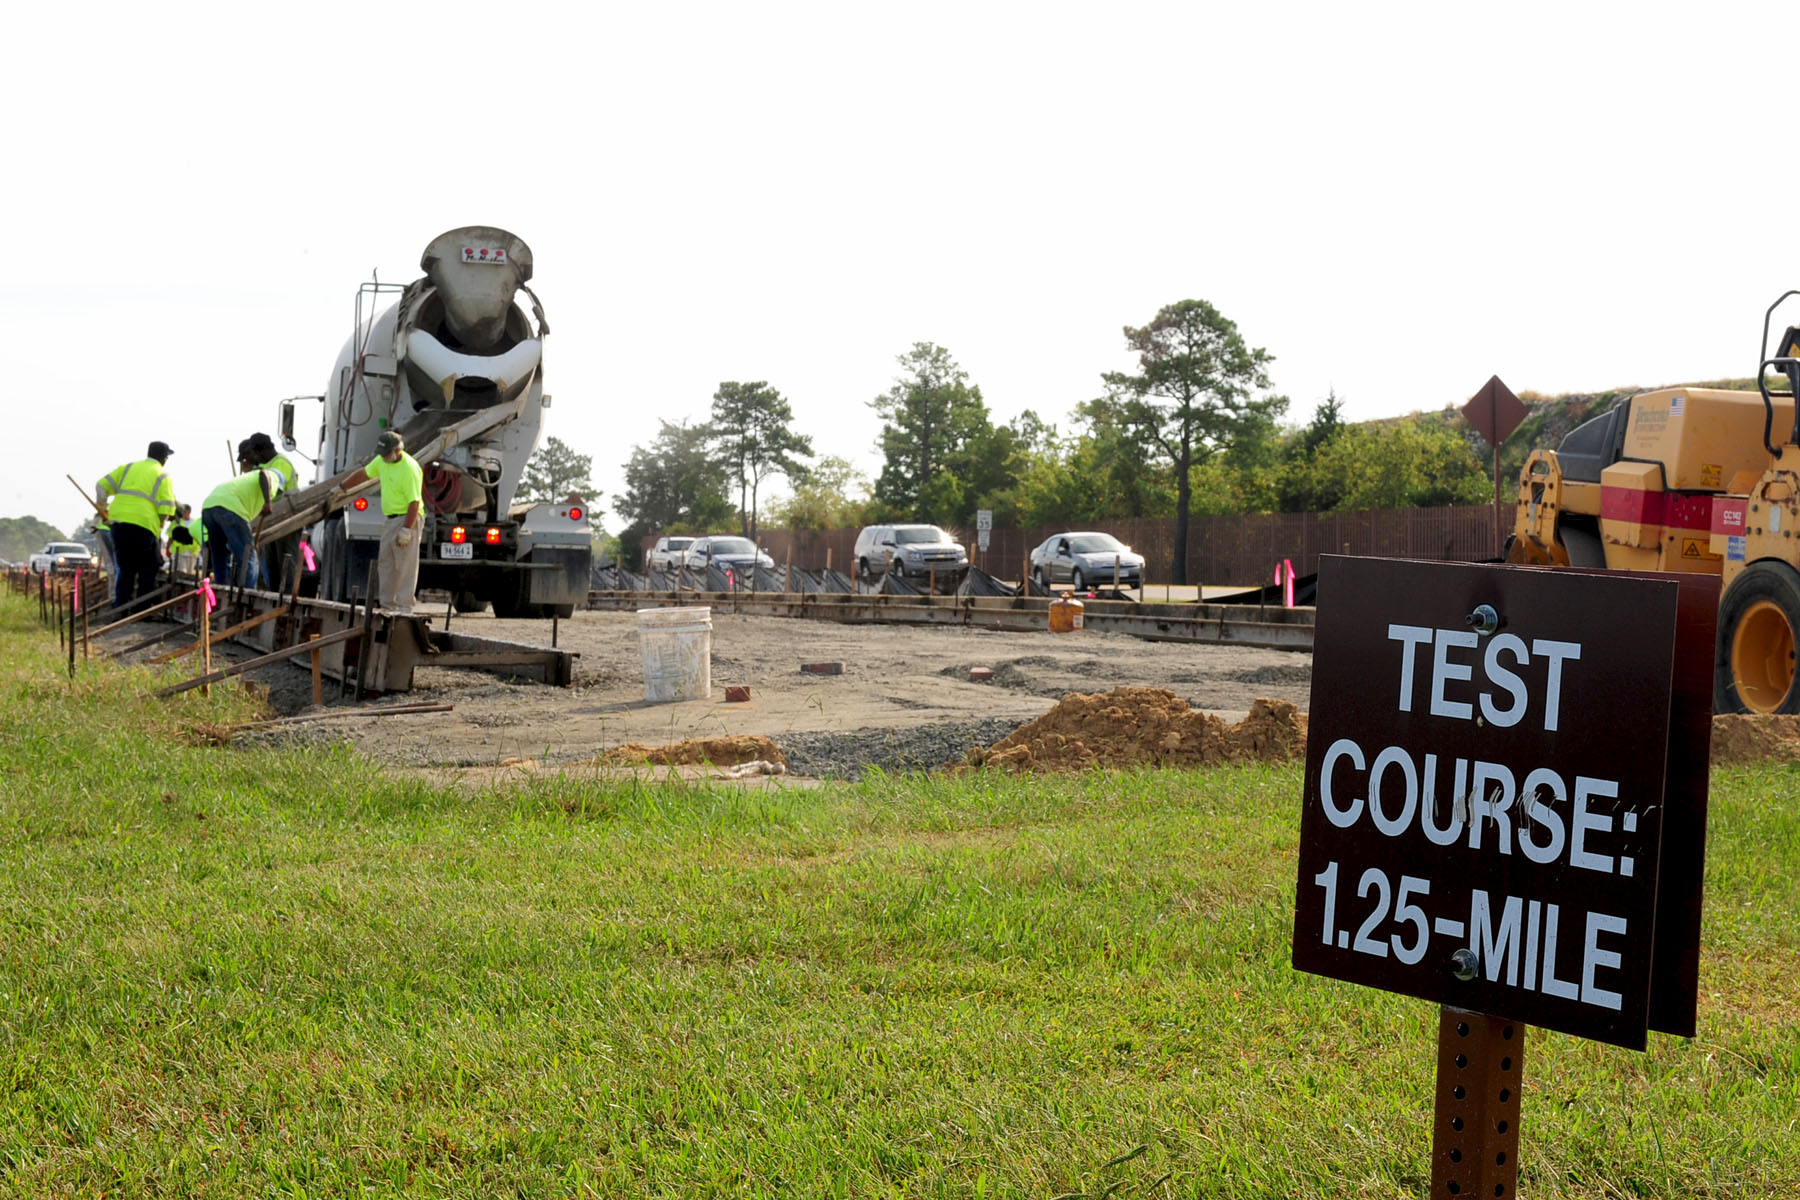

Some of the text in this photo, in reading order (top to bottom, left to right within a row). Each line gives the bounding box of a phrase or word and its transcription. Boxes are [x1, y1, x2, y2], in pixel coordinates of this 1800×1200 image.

[1388, 624, 1581, 732] TEST
[1319, 738, 1639, 878] COURSE:
[1314, 861, 1629, 1012] 1.25-MILE
